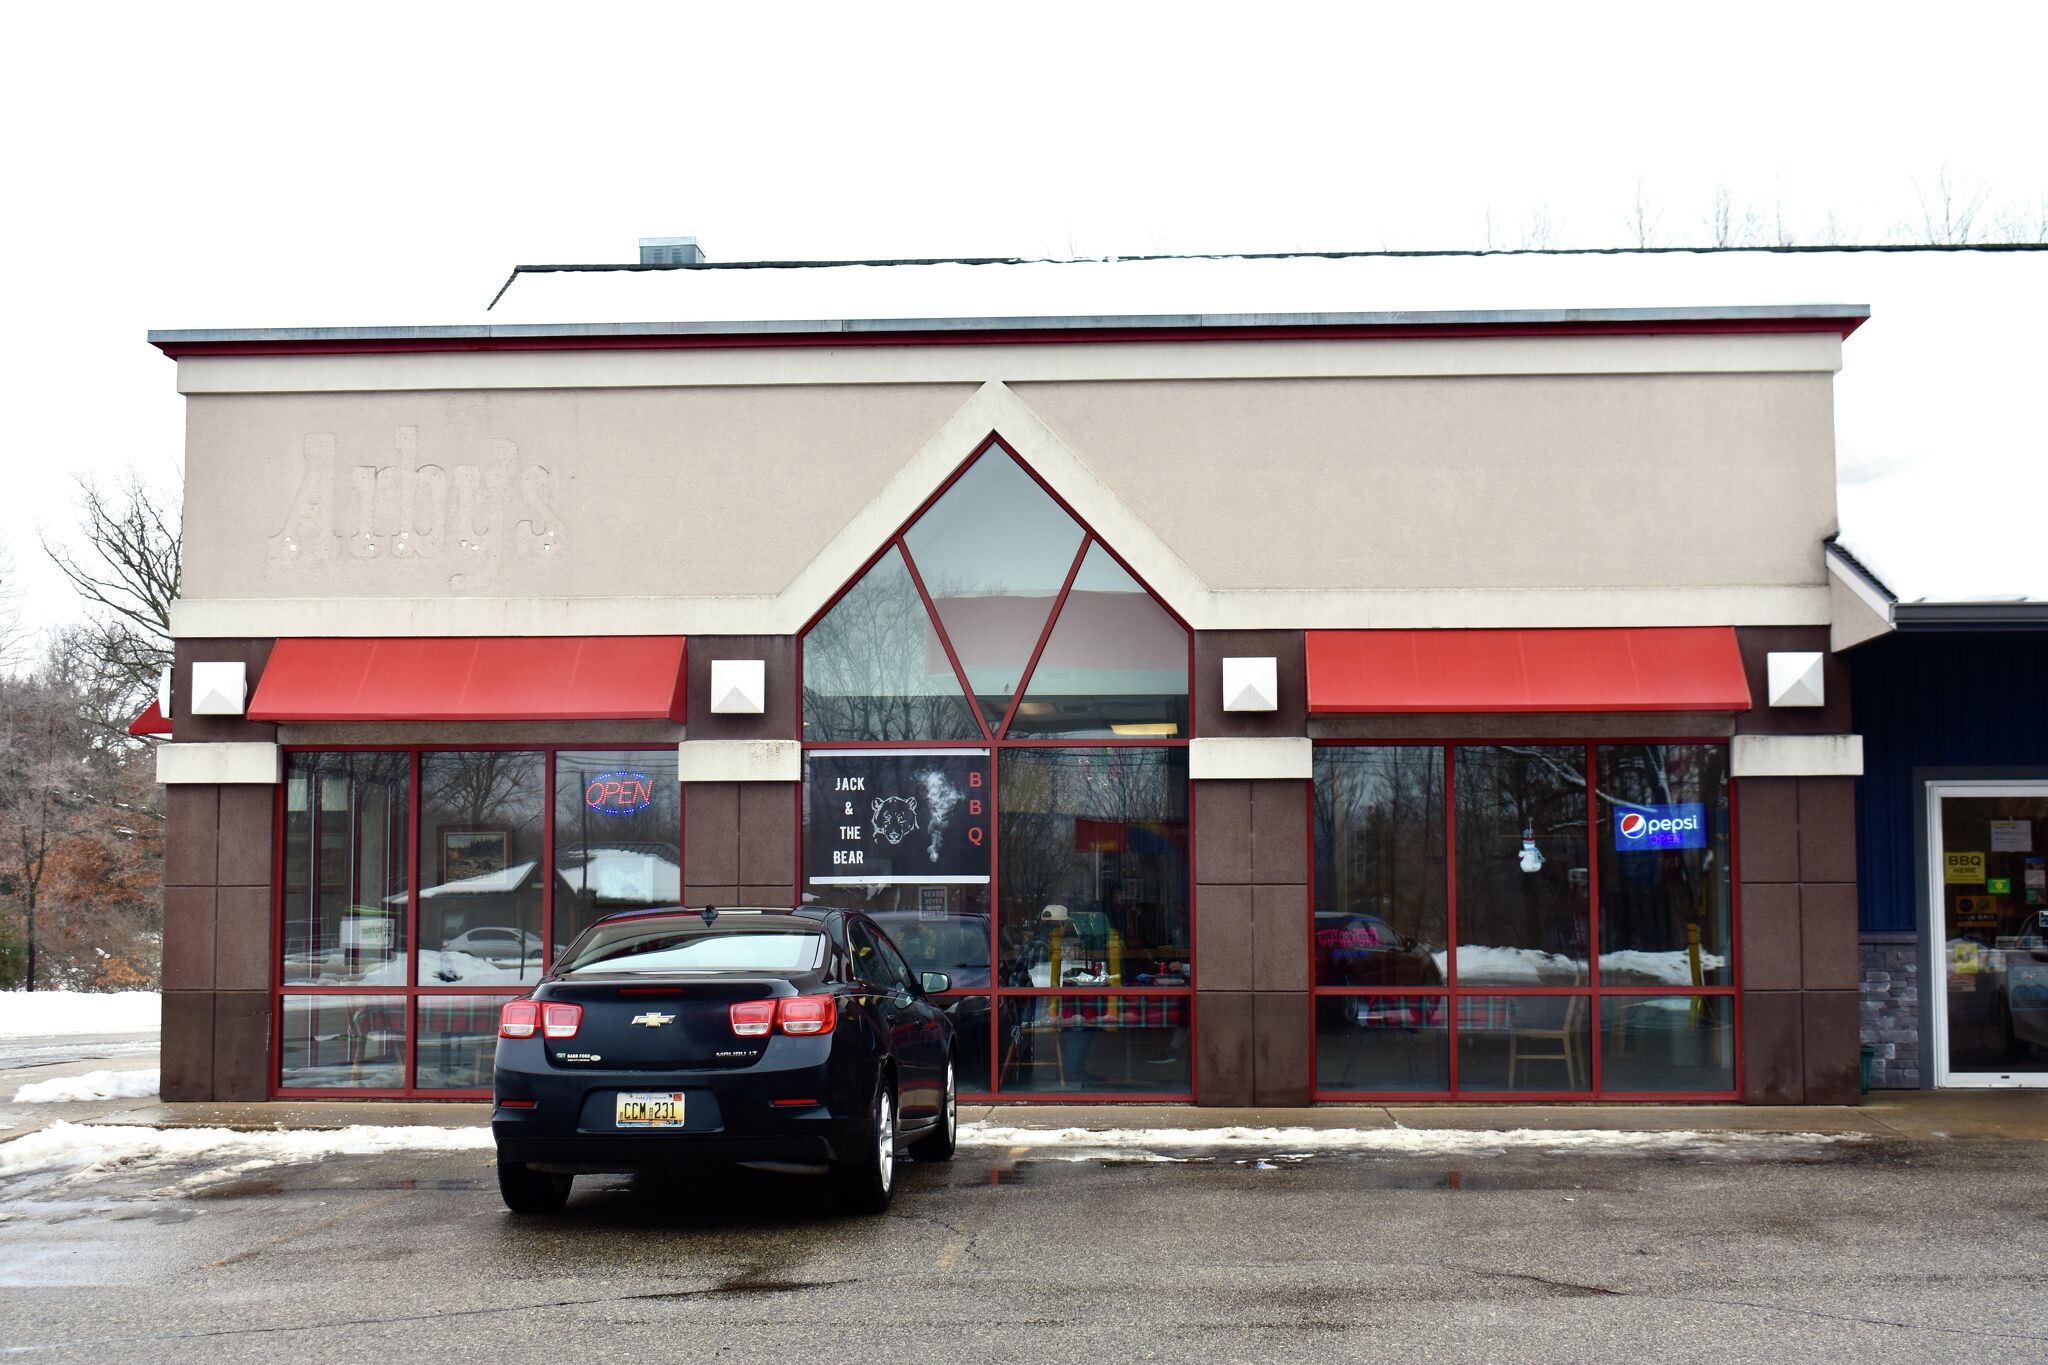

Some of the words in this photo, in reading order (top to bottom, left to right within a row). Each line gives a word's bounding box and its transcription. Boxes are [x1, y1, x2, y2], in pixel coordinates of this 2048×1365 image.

[835, 777, 865, 791] JACK
[585, 780, 653, 805] OPEN
[844, 801, 853, 815] &
[1648, 815, 1697, 834] pepsi
[839, 826, 861, 840] THE
[1649, 833, 1681, 845] OPEN
[833, 850, 864, 865] BEAR
[1948, 855, 1982, 867] BBQ
[624, 1102, 646, 1119] CCM
[654, 1102, 676, 1119] 231
